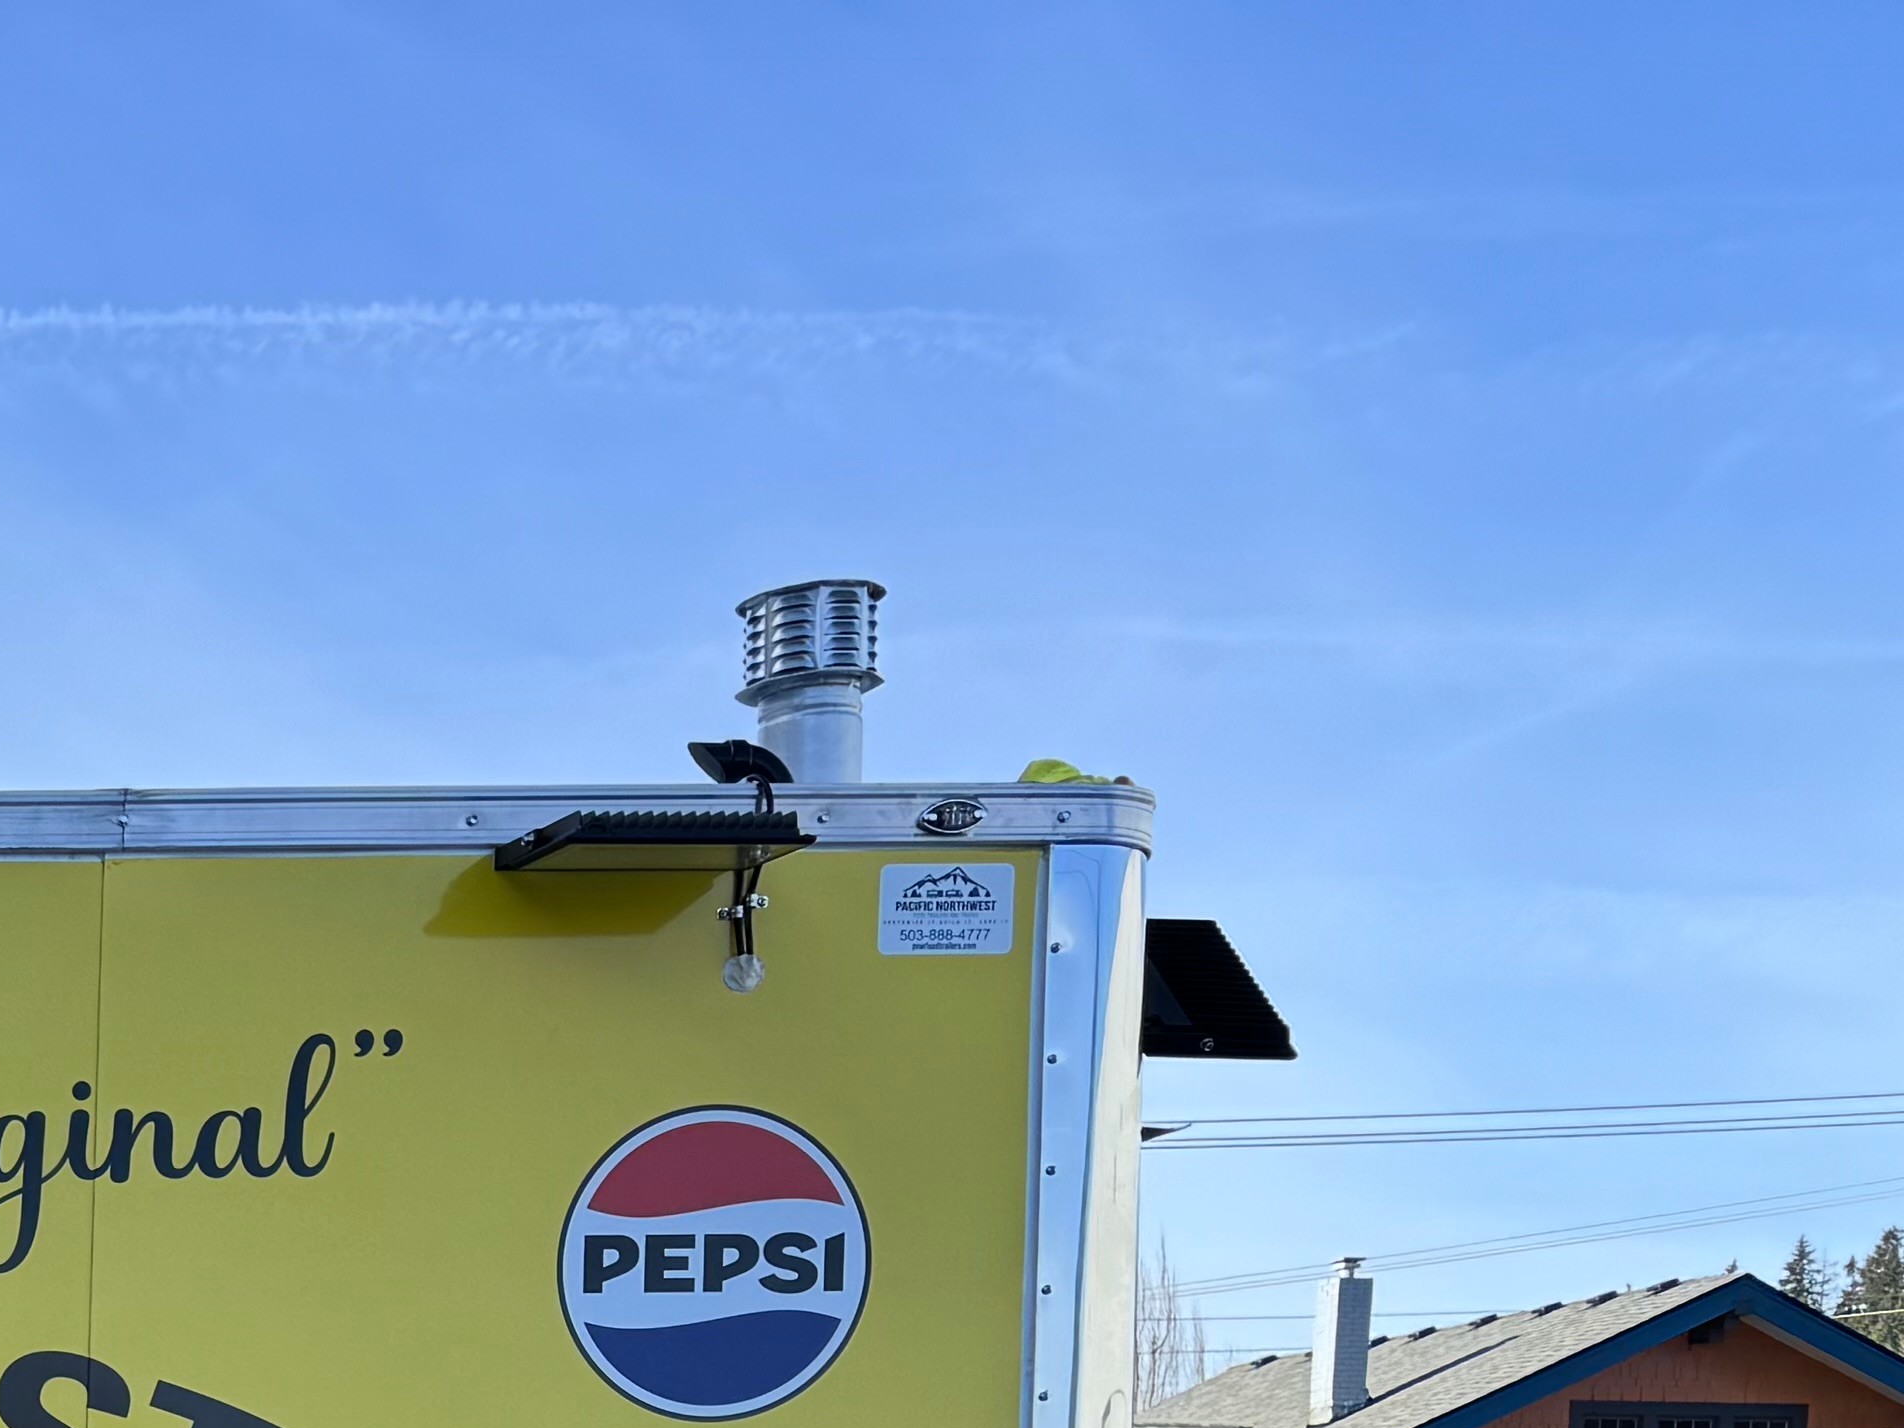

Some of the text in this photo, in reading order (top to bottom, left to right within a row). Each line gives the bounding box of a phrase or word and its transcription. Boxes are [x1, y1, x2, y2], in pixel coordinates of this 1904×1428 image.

[895, 900, 997, 912] PACIFIC NORTHWEST
[899, 928, 991, 941] 503-888-4777
[583, 1232, 845, 1294] PEPSI
